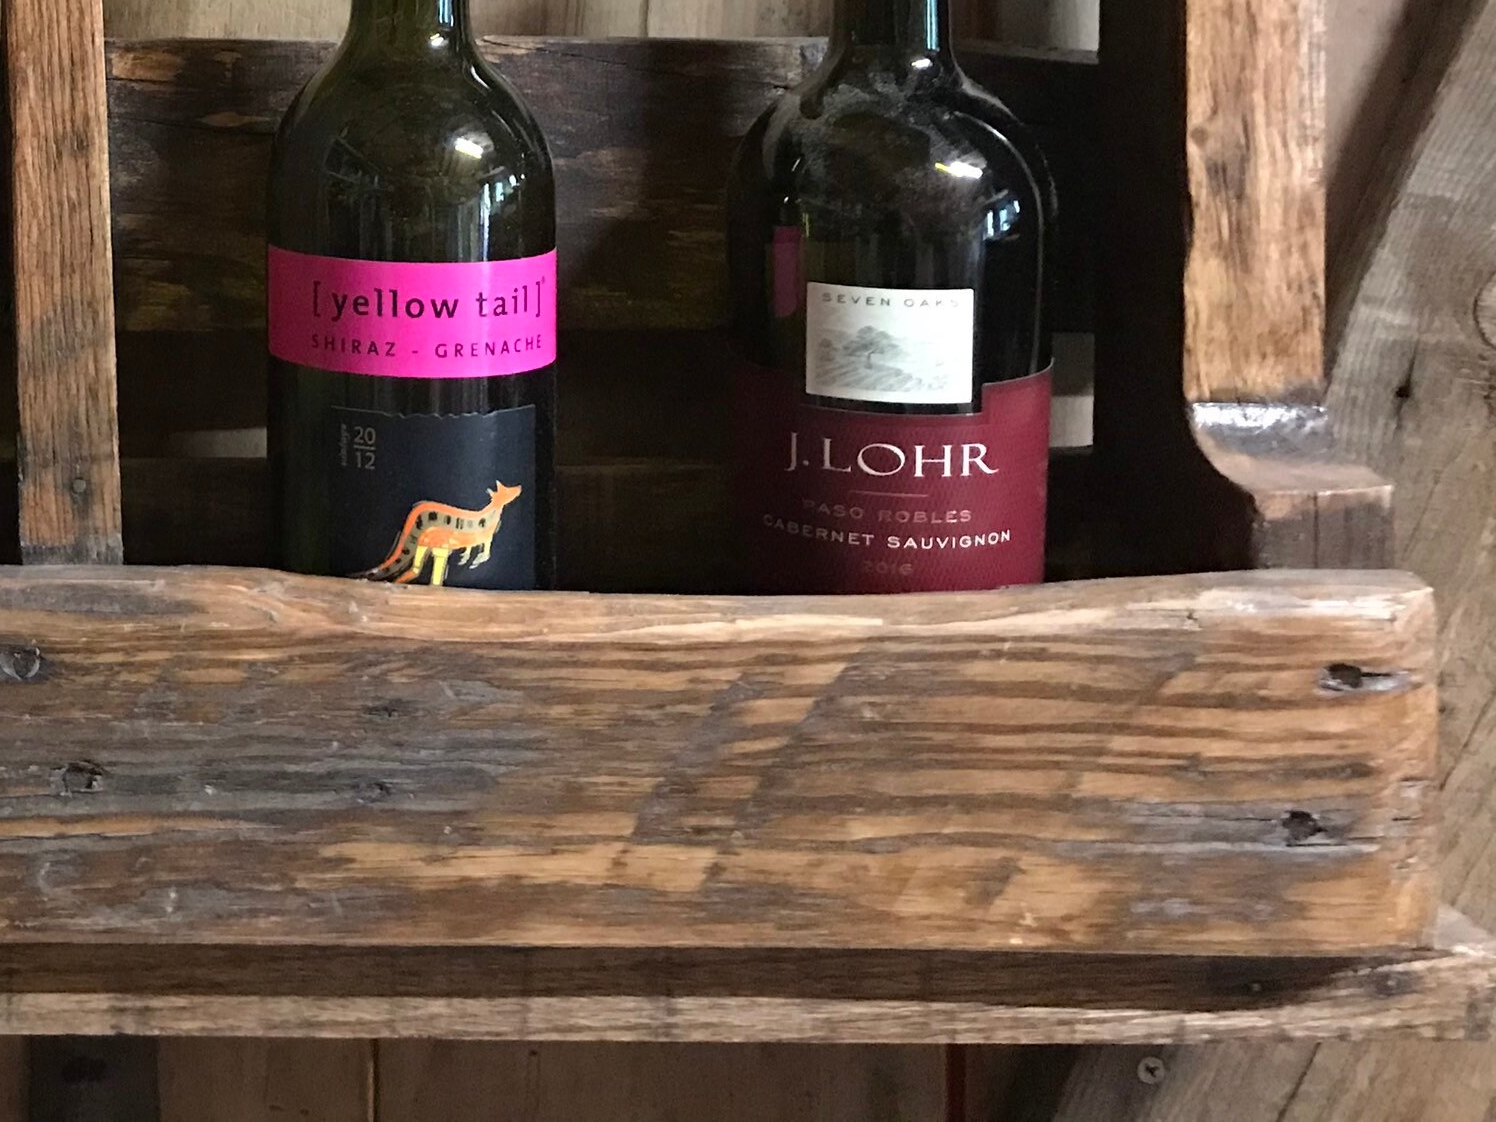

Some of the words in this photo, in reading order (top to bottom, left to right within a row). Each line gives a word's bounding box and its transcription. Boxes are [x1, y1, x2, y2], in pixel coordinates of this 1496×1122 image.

[821, 291, 891, 307] SEVEN
[311, 333, 396, 358] SHIRAZ
[434, 334, 542, 359] GRENACHE
[353, 425, 377, 445] 20
[354, 451, 376, 470] 12
[803, 499, 865, 520] PASO
[877, 509, 973, 524] ROBLES
[762, 513, 875, 547] CABERNET
[886, 529, 1011, 551] SAUVIGNON
